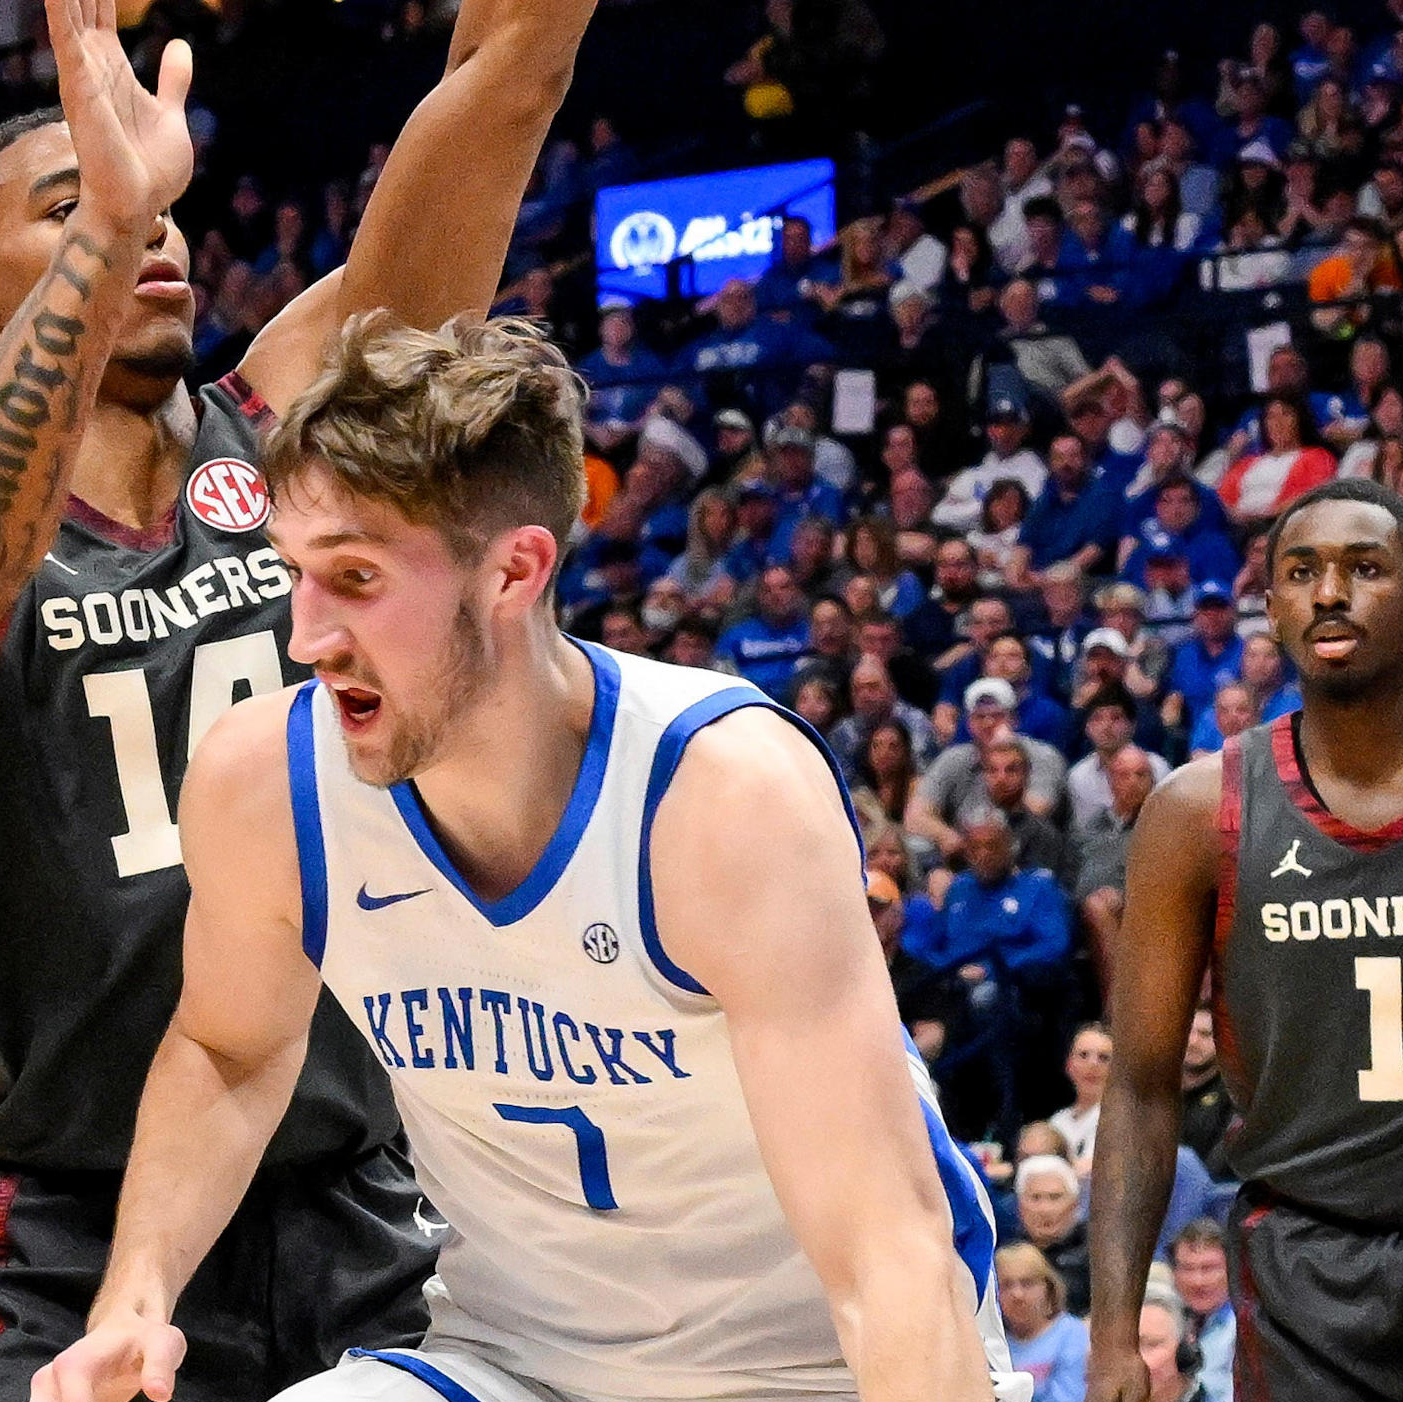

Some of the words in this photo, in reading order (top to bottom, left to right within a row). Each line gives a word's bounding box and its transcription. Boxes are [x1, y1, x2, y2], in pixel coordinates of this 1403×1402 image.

[192, 459, 266, 529] SEC
[40, 547, 293, 651] SOONERS
[363, 987, 692, 1085] KENTUCKY
[492, 1103, 619, 1210] 7
